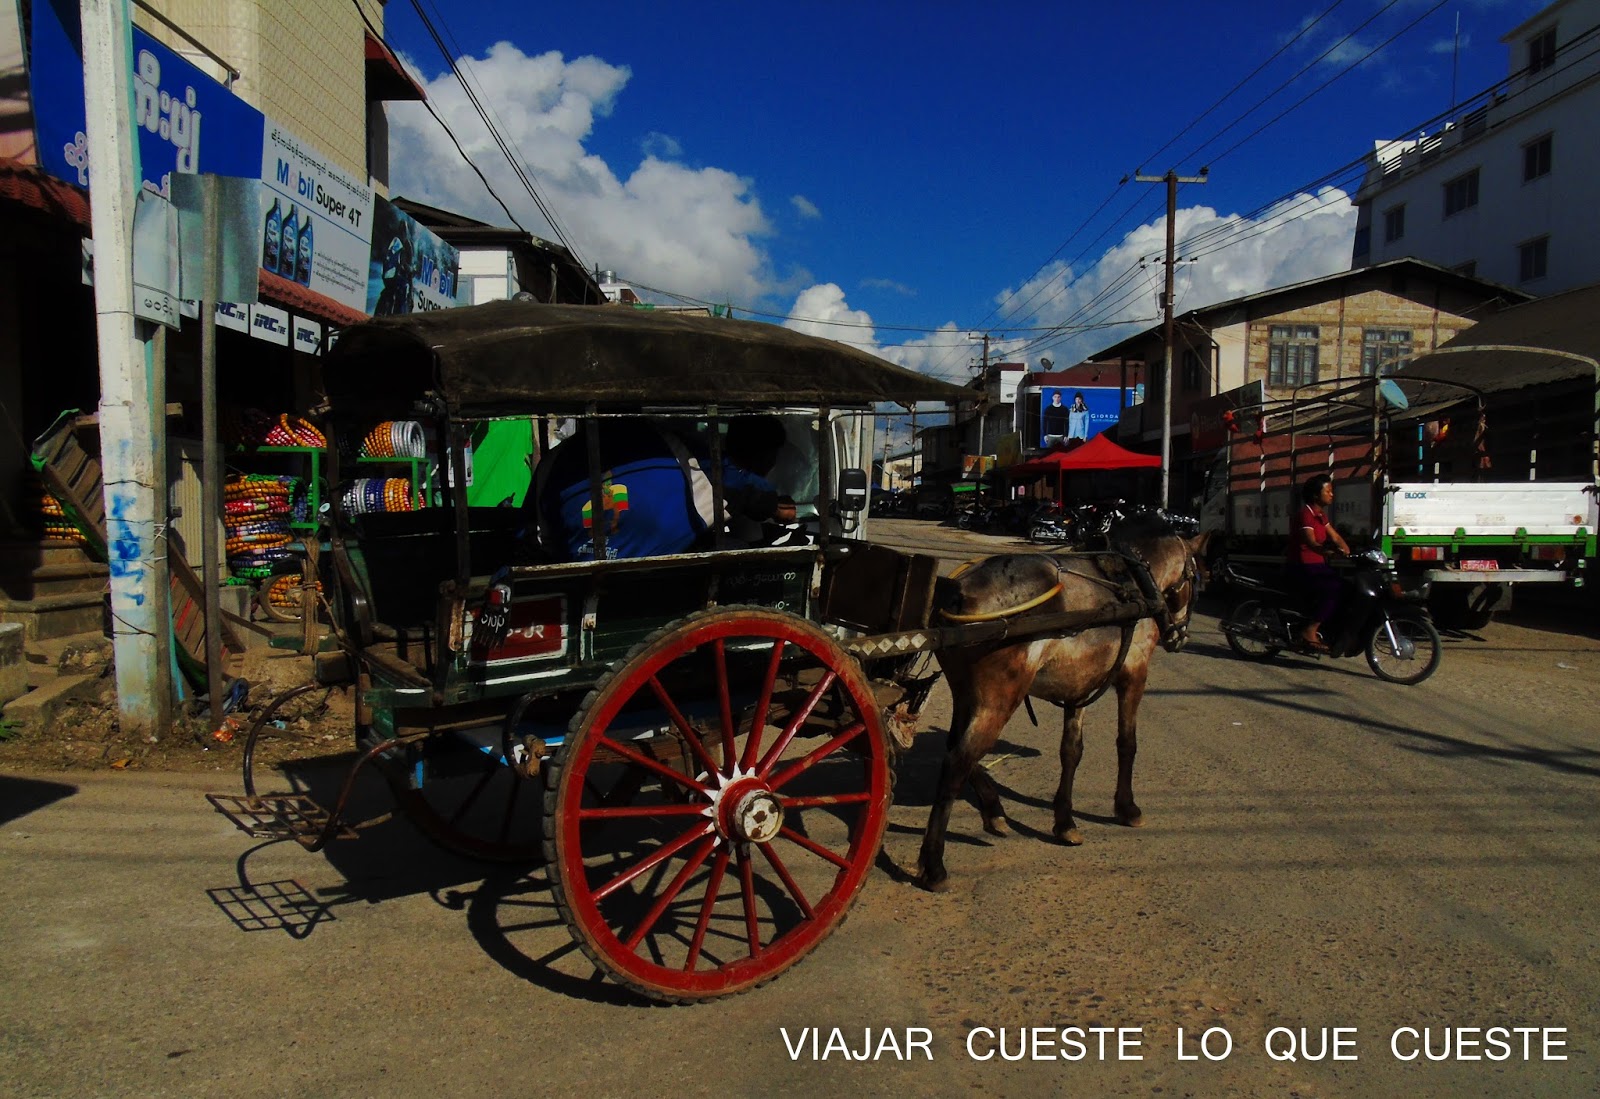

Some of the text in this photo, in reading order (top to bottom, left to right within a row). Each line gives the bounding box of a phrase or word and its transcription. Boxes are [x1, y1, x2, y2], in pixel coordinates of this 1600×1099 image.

[276, 157, 361, 228] Mobil Super 4T
[420, 253, 454, 299] Mobil
